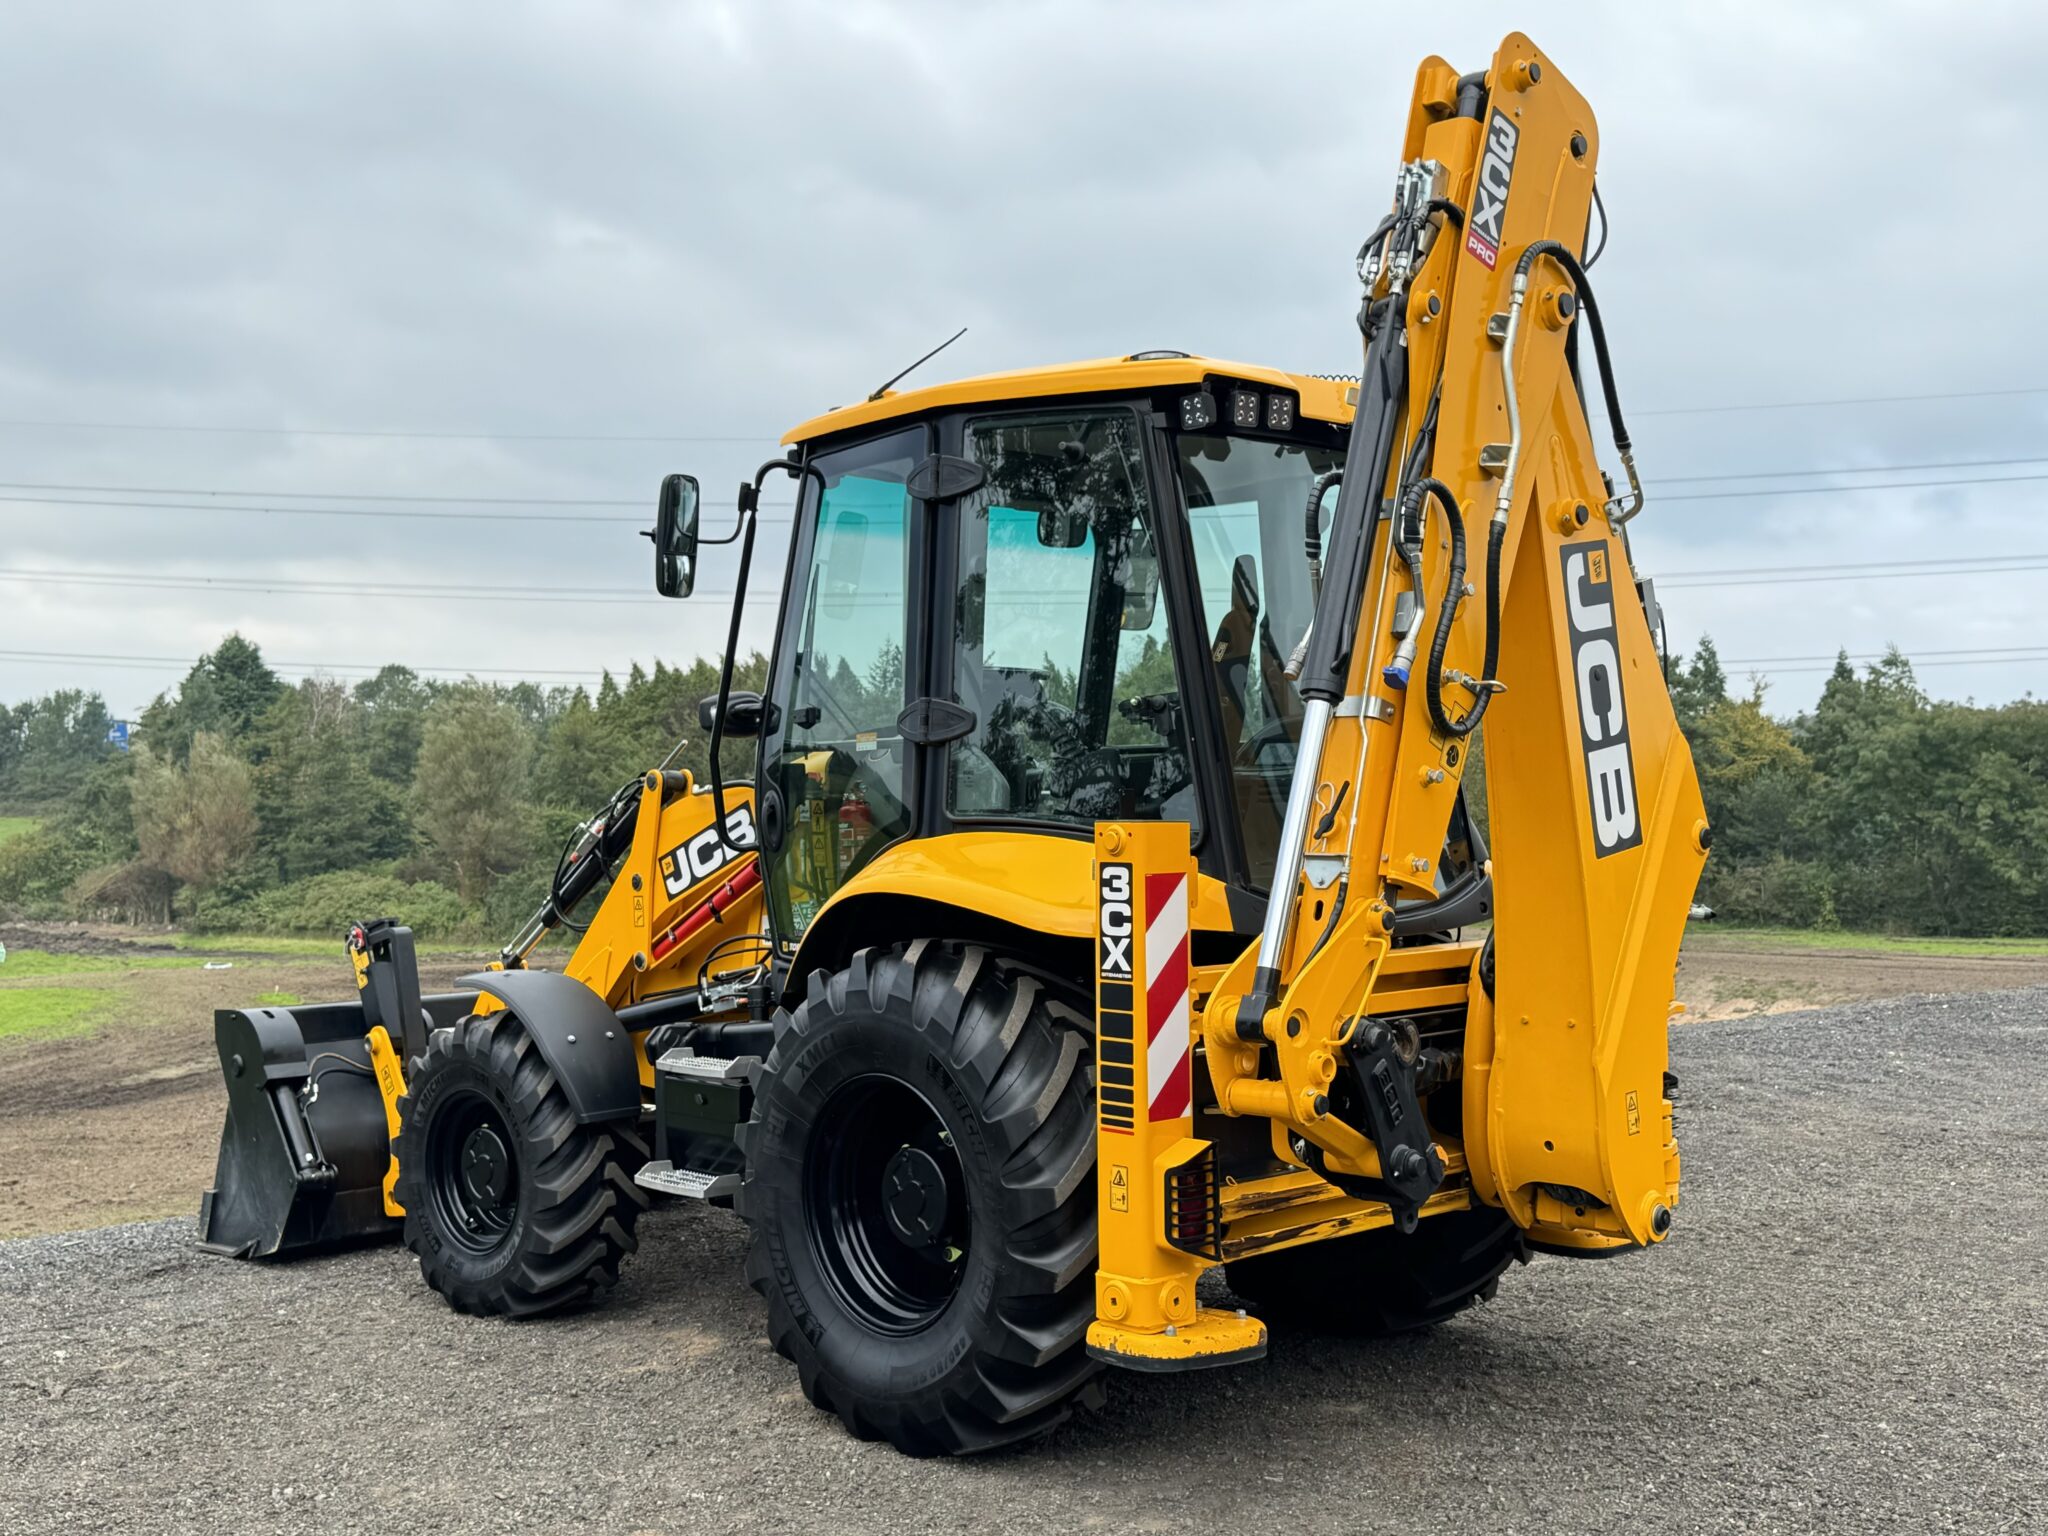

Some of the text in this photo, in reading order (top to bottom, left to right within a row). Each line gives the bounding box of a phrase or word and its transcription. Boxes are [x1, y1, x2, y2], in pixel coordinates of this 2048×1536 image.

[1473, 114, 1516, 241] 3CX
[1468, 236, 1496, 266] PRO
[1592, 557, 1602, 578] JCB
[1566, 552, 1636, 848] JCB
[665, 808, 756, 895] JCB
[1101, 866, 1132, 971] 3CX
